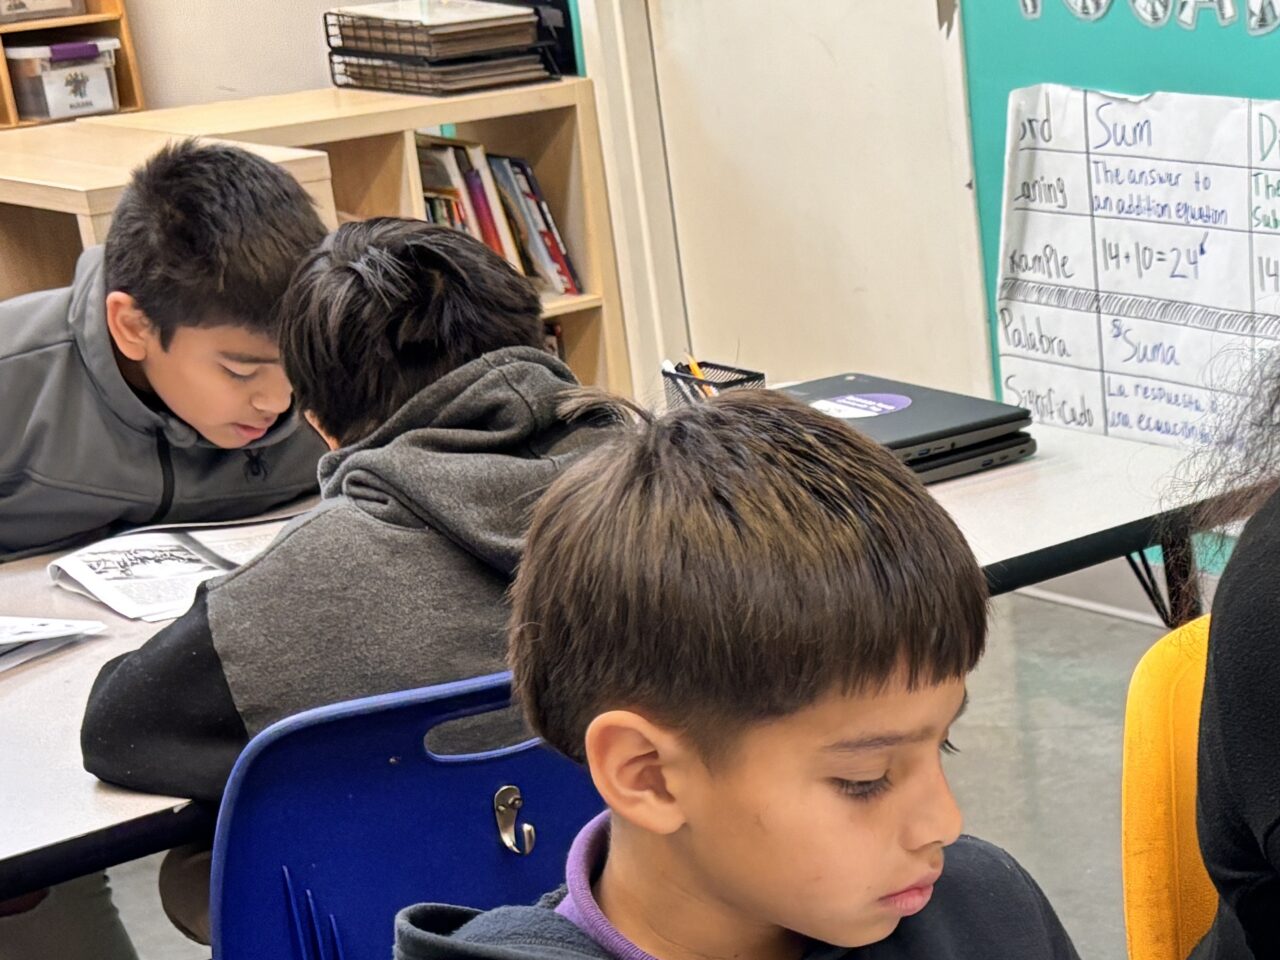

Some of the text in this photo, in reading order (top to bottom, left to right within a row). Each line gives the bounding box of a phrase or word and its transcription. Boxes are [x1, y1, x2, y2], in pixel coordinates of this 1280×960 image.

[1093, 102, 1153, 149] Sum
[1092, 160, 1120, 185] The
[1194, 171, 1211, 192] to
[1092, 193, 1113, 212] an
[1000, 307, 1072, 358] Palabra
[1122, 330, 1181, 366] Suma
[1107, 376, 1128, 397] La
